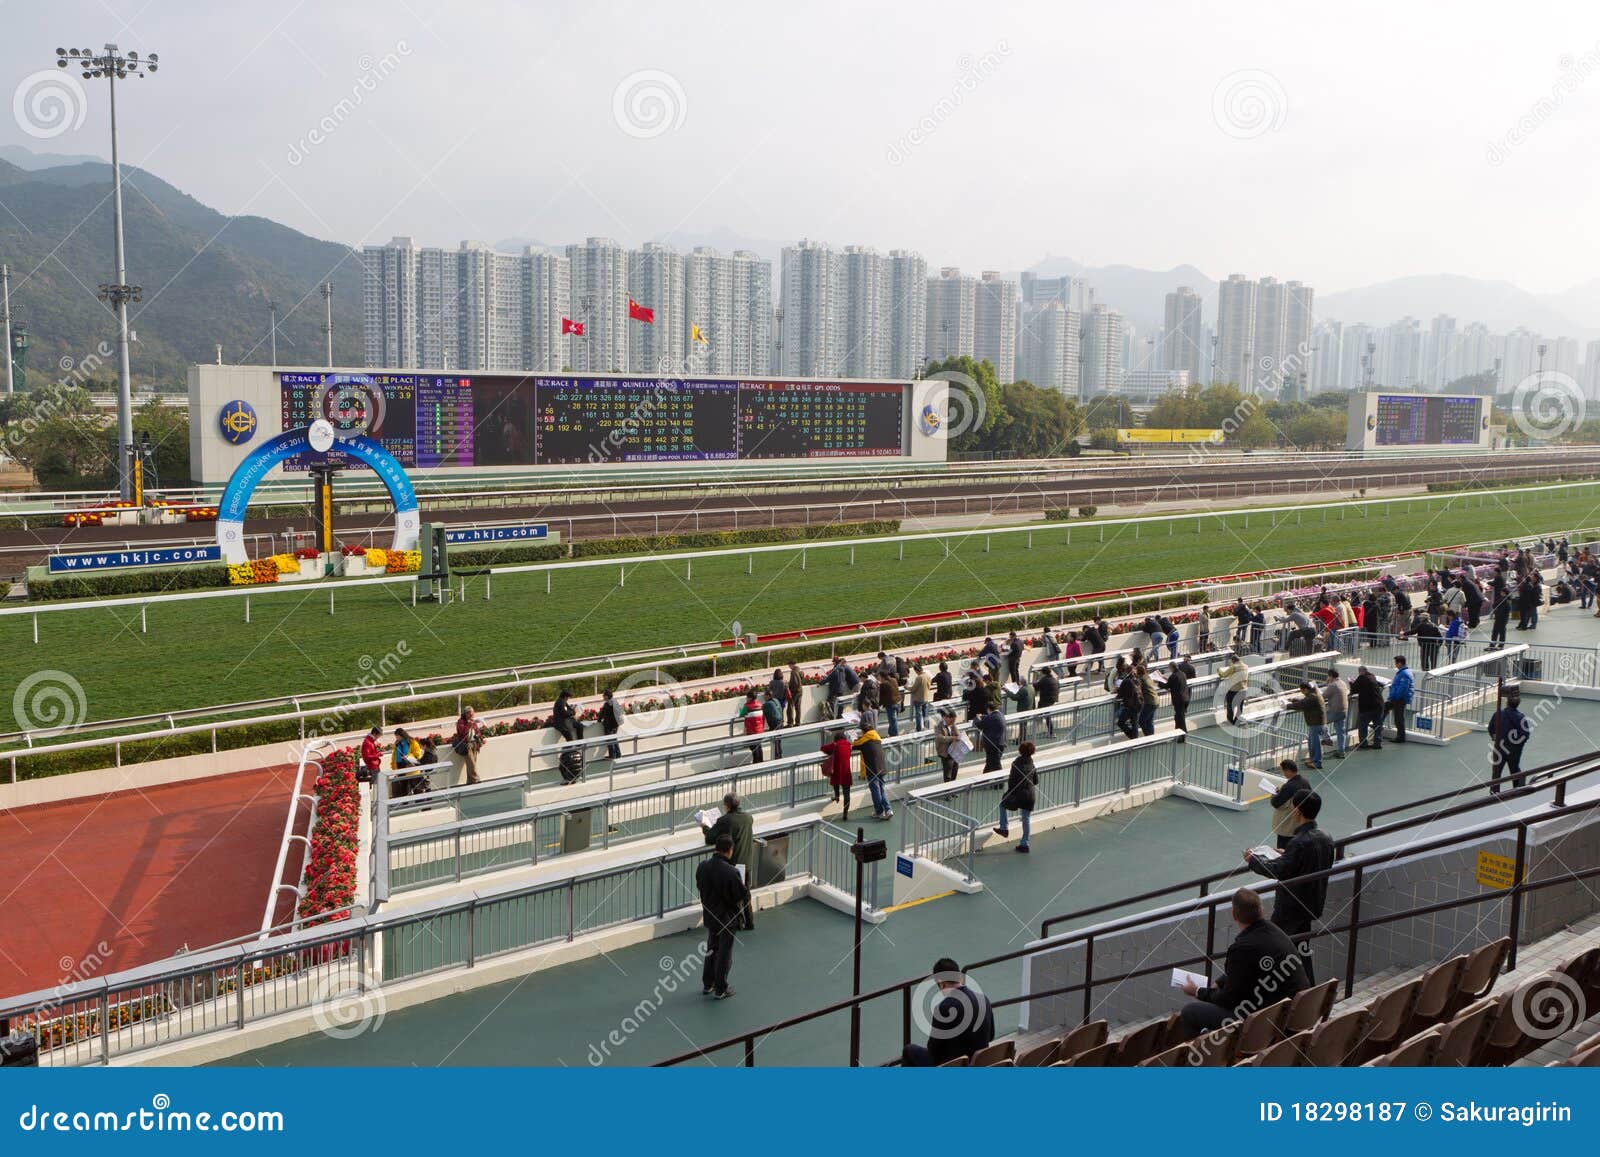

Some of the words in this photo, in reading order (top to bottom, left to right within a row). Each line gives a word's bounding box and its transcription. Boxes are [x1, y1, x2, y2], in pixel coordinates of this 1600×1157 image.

[240, 452, 272, 488] CENTENARY
[271, 442, 289, 454] VASE
[289, 437, 305, 446] 2011
[446, 528, 538, 540] ww.hkjc.com
[67, 549, 208, 567] www.hkjc.com
